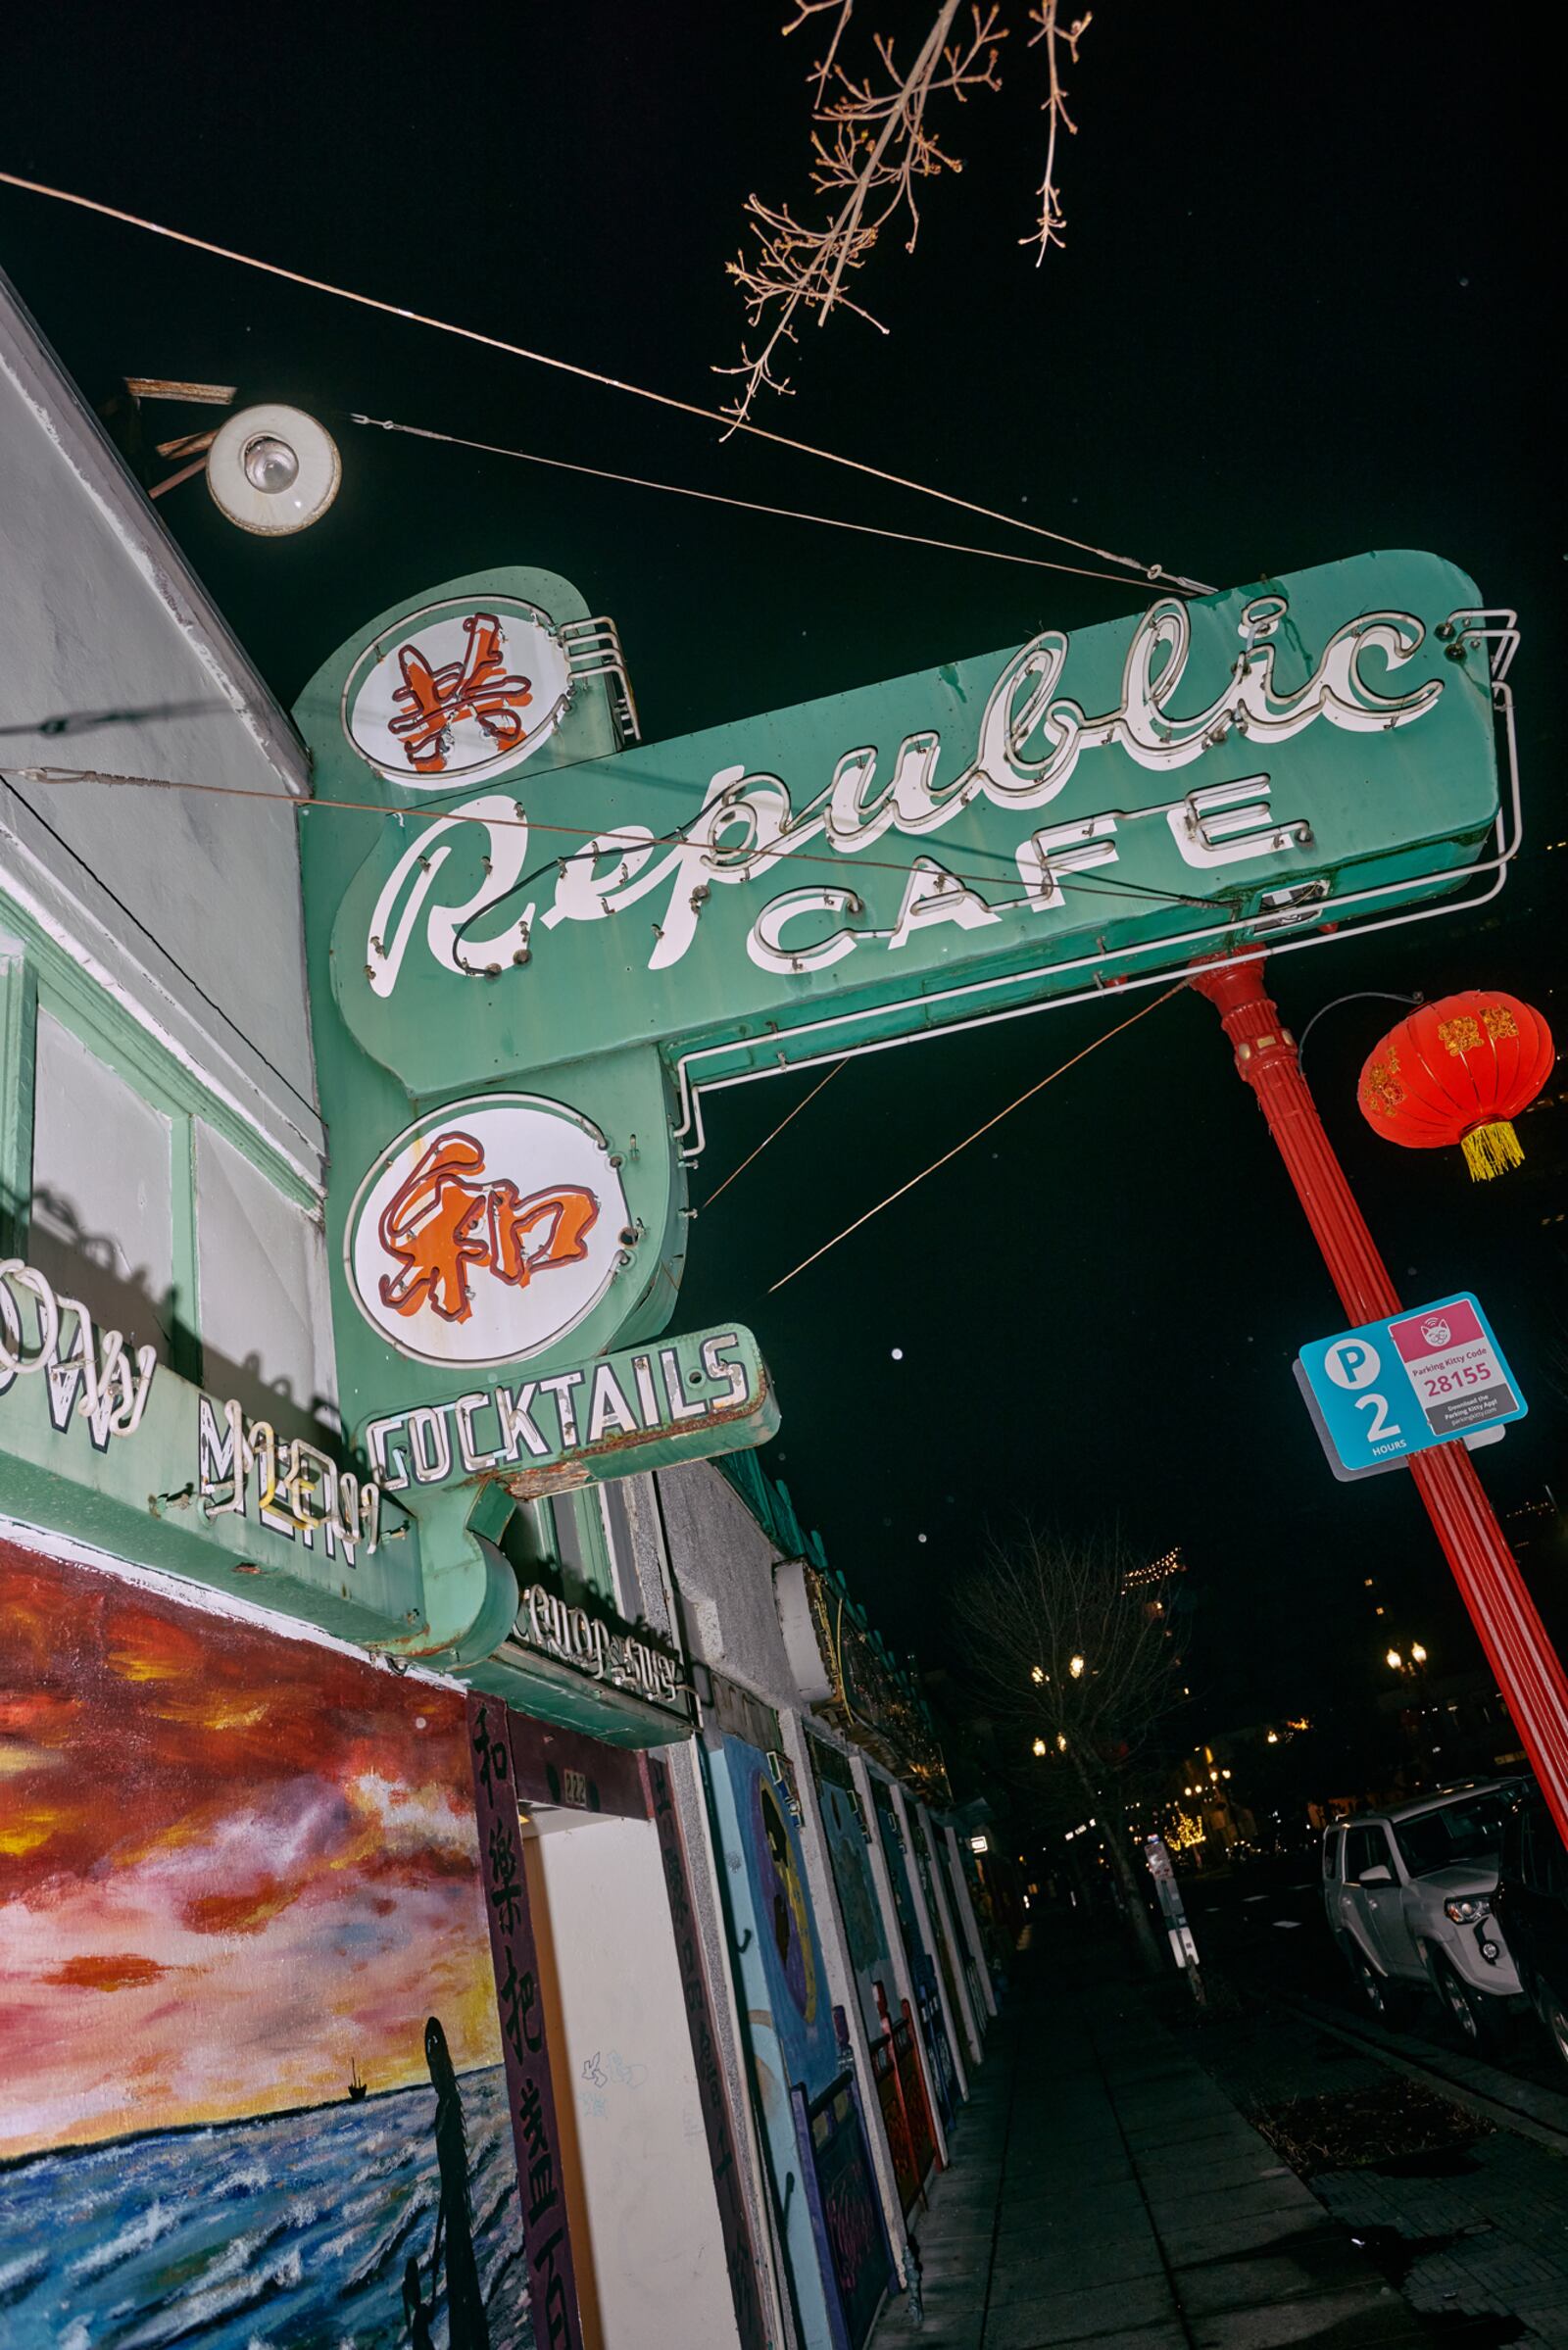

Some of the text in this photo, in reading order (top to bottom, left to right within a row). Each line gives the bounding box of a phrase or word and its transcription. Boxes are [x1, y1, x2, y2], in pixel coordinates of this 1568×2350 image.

[367, 596, 1445, 998] Republic
[747, 773, 1309, 974] CAFE
[379, 1132, 601, 1324] 和
[1337, 1346, 1366, 1384] P
[1412, 1347, 1487, 1377] Parking Kitty Code
[1424, 1362, 1492, 1396] 28155
[366, 1332, 749, 1491] COCKTAILS
[1354, 1393, 1401, 1443] 2
[1445, 1408, 1468, 1420] Parking
[1468, 1403, 1484, 1413] Kitty
[1447, 1395, 1489, 1411] Download the
[1372, 1440, 1407, 1456] HOURS
[198, 1394, 380, 1570] MEIN
[565, 1772, 586, 1803] 222
